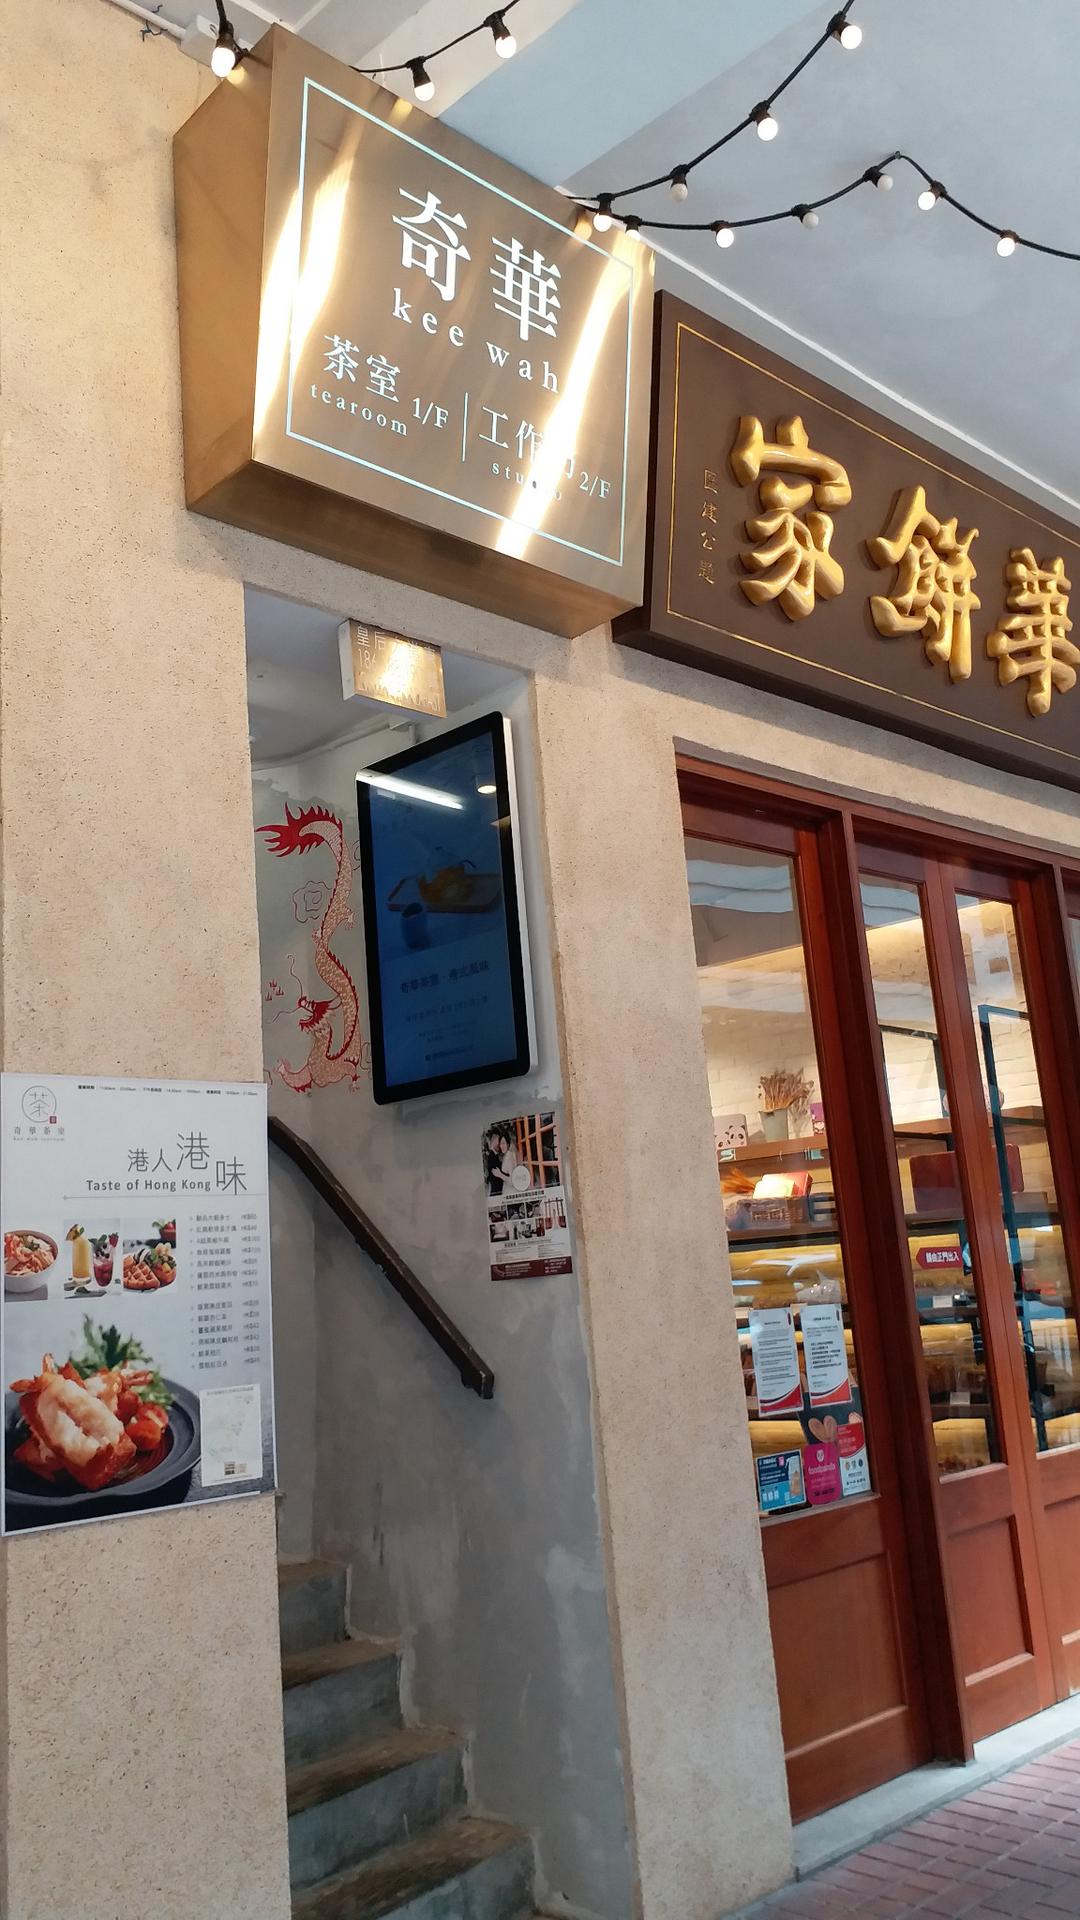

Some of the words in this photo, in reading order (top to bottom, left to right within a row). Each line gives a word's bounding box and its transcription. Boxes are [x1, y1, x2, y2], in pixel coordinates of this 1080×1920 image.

[392, 187, 562, 342] 奇華
[392, 287, 465, 348] kee
[486, 340, 560, 394] wah
[310, 383, 409, 437] tearoom
[323, 335, 402, 404] 茶室
[412, 397, 450, 431] 1/F
[478, 405, 575, 480] 工作
[579, 471, 611, 499] 2/F
[491, 462, 562, 501] stuo
[86, 1179, 121, 1191] Taste
[126, 1179, 139, 1191] of
[144, 1179, 176, 1192] Hong
[182, 1179, 211, 1192] Kong
[127, 1131, 247, 1196] 港人港味
